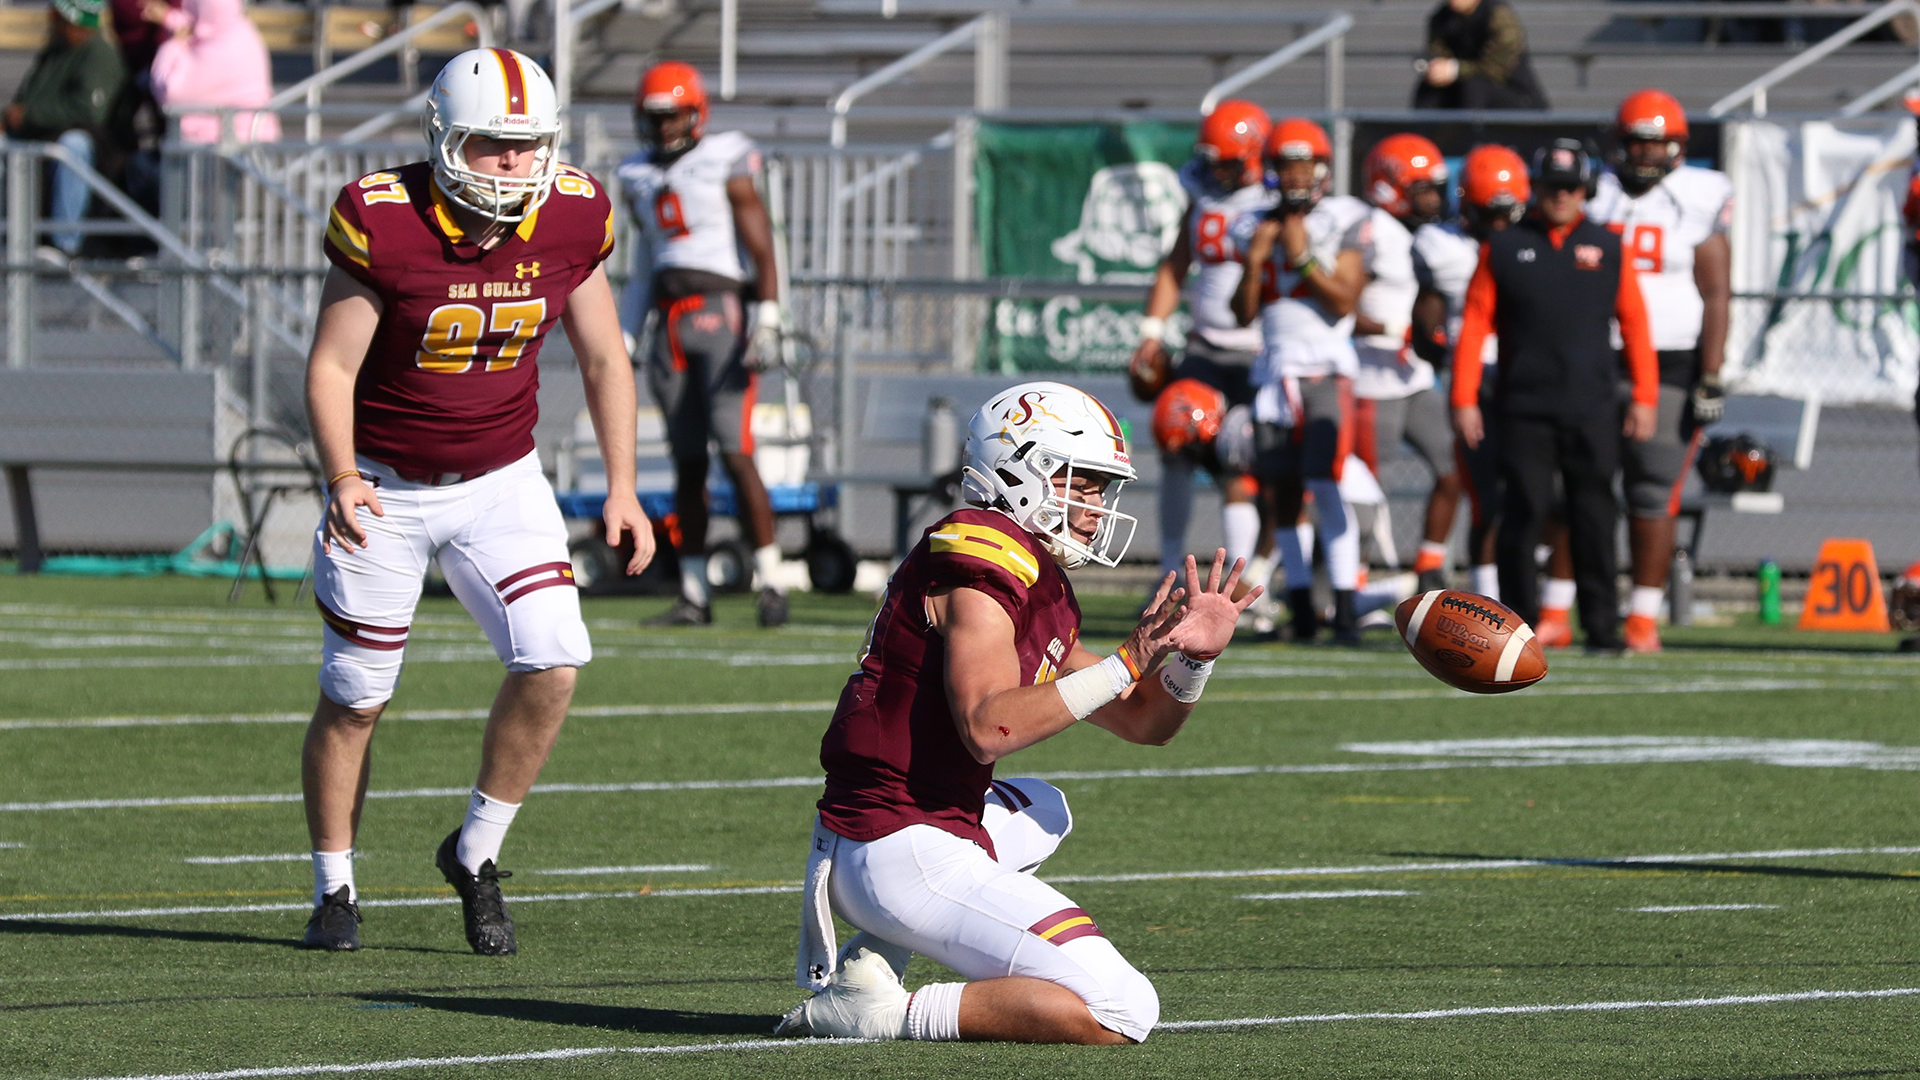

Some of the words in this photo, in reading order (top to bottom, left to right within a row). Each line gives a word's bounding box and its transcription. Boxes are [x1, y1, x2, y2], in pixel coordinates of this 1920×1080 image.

[503, 116, 530, 125] Riddell
[448, 283, 477, 299] SEA
[482, 282, 532, 298] GULLS
[415, 297, 547, 374] 97
[1814, 562, 1872, 615] 30
[1437, 615, 1489, 649] Wilson
